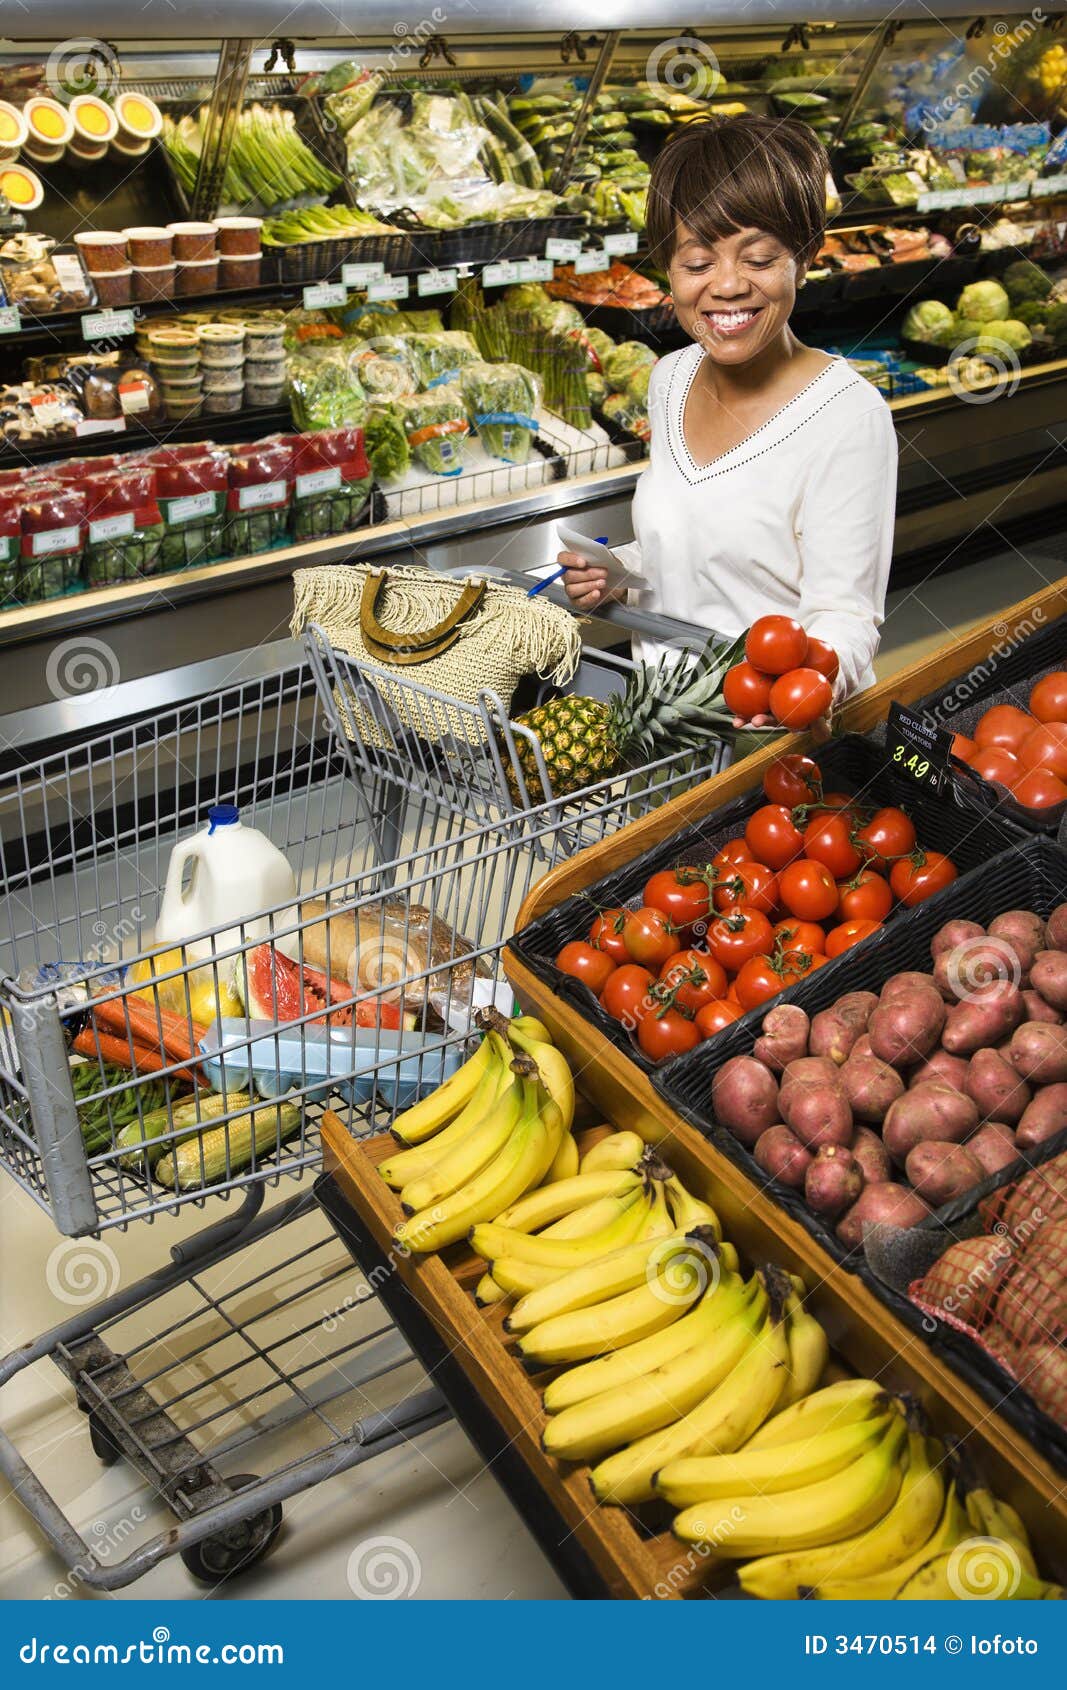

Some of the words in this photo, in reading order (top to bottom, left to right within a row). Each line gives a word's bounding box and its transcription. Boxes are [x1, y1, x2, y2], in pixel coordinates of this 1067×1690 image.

[898, 713, 912, 726] RED
[911, 721, 938, 741] CLUSTER
[893, 745, 930, 778] 3.49
